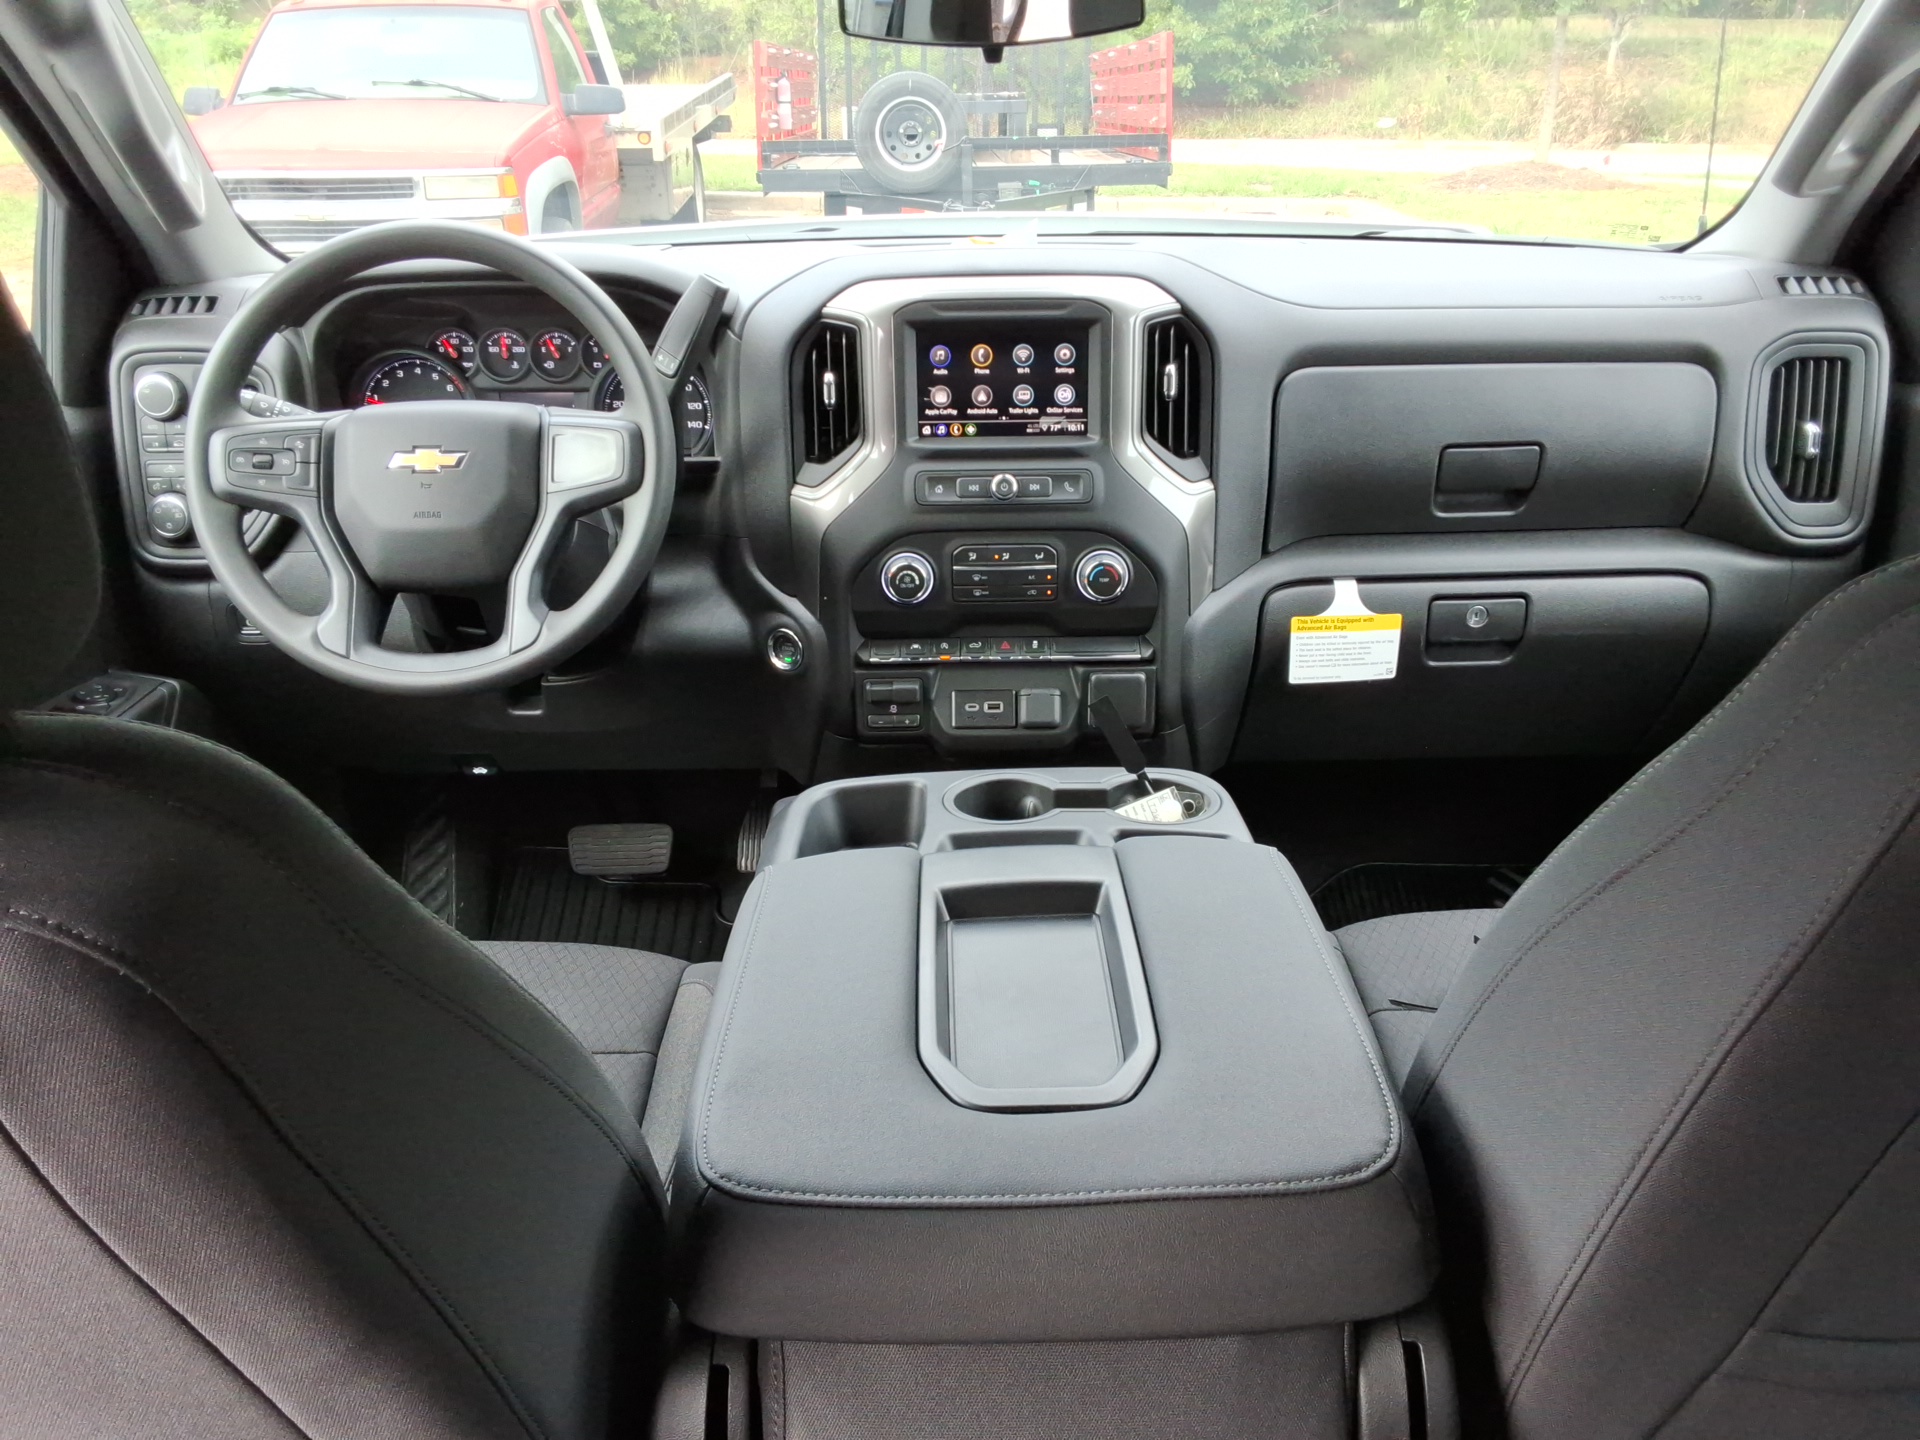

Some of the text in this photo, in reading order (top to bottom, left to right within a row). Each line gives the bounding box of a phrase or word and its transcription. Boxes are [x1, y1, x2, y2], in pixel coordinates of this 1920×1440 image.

[925, 408, 958, 416] Apple CarPlay
[1023, 407, 1039, 416] Lights
[413, 510, 442, 518] AIRBAG
